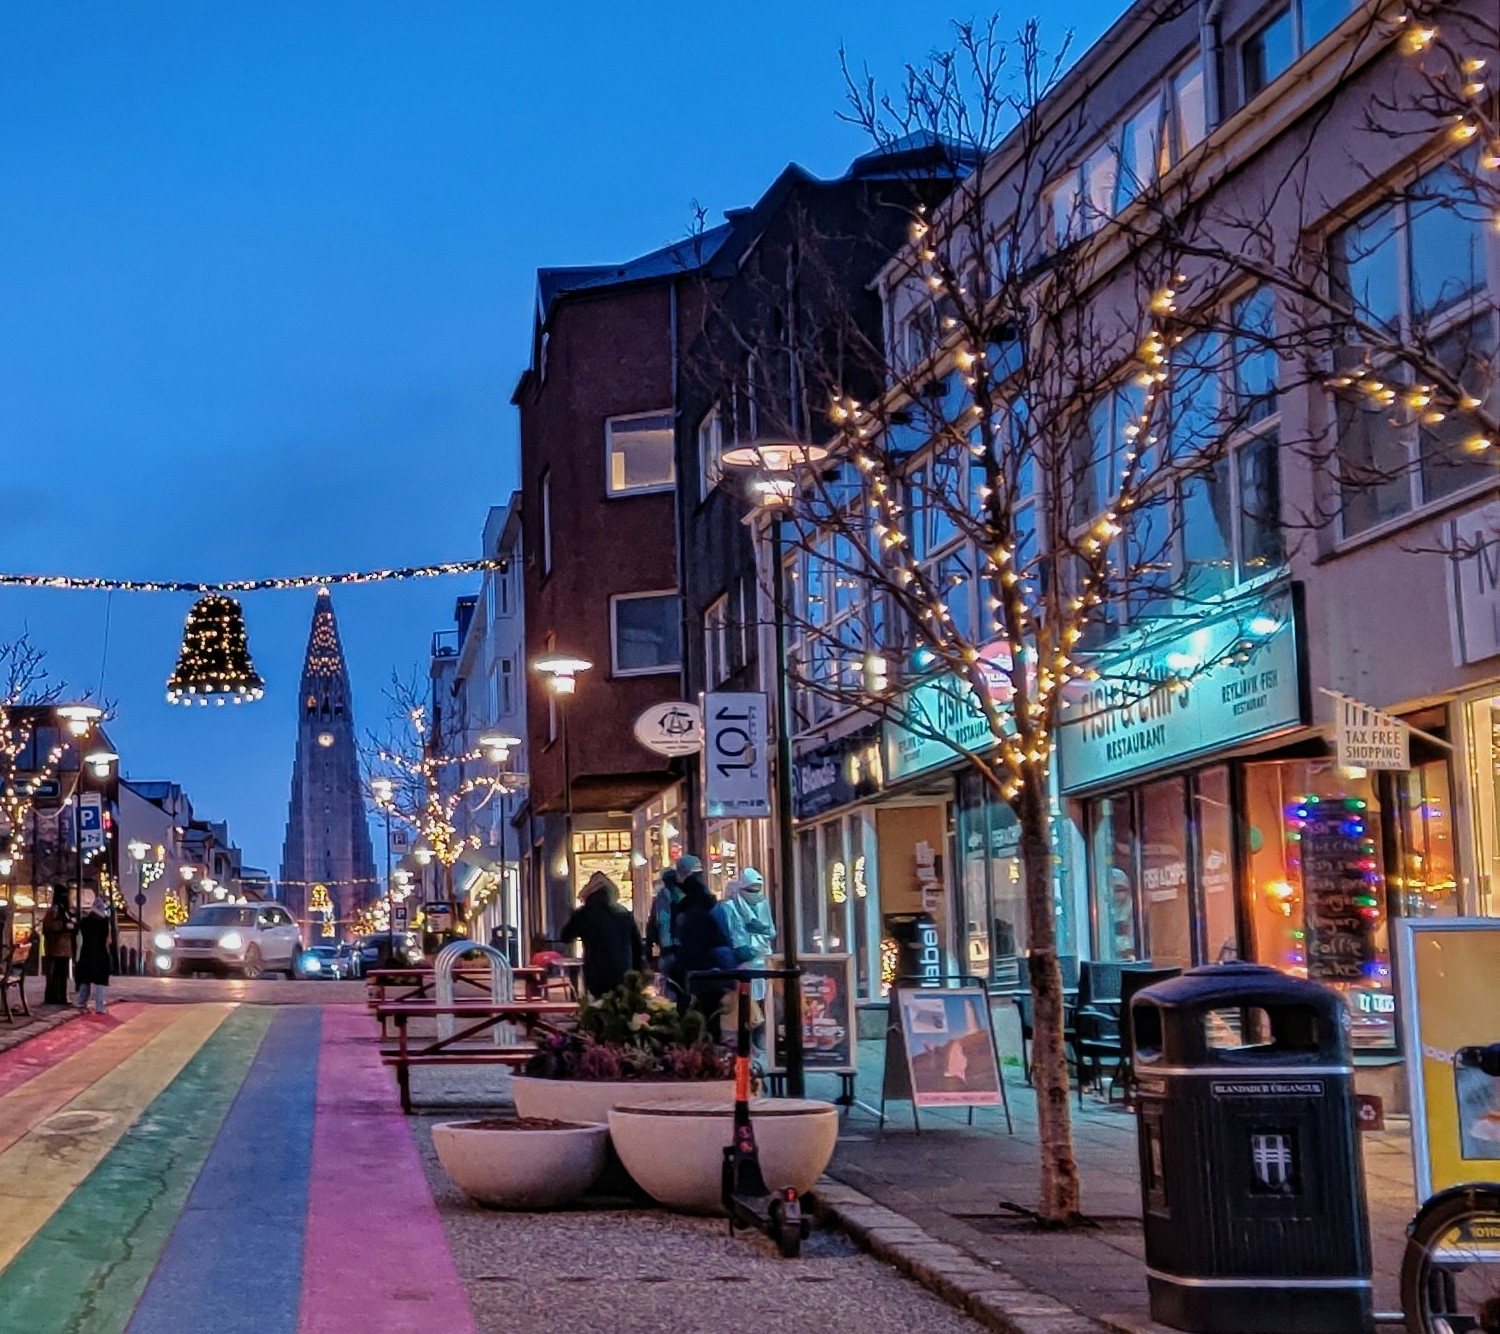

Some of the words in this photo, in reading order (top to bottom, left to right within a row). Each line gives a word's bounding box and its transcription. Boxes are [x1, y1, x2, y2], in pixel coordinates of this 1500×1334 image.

[956, 719, 990, 744] RESTAURA
[1345, 731, 1367, 745] TAX
[1372, 731, 1402, 745] FREE
[1106, 725, 1165, 762] RESTAURANT
[1346, 746, 1401, 759] SHOPPING
[80, 809, 94, 827] P
[918, 924, 940, 987] label
